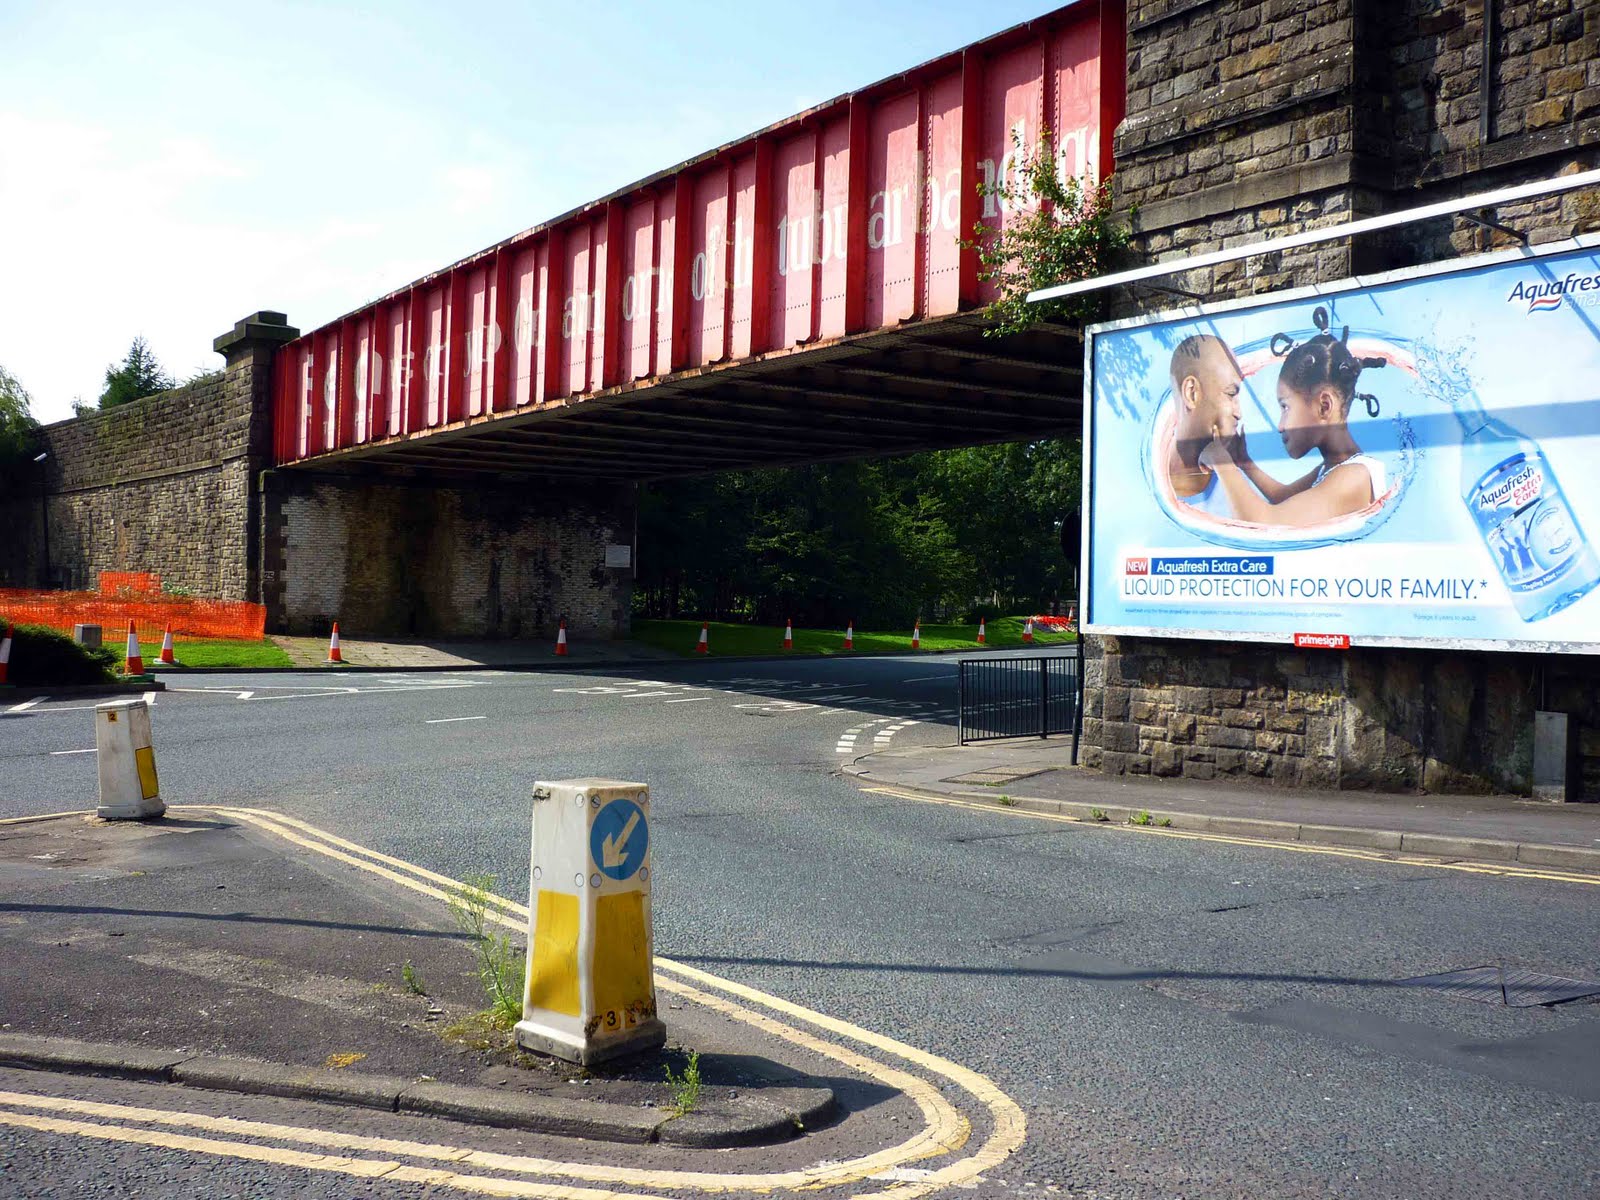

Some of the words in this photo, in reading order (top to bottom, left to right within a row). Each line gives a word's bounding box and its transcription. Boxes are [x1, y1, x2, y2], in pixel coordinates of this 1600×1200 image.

[1480, 466, 1535, 508] Aquafresh
[1126, 561, 1147, 572] NEW
[1156, 560, 1209, 576] Aquafresh
[1211, 560, 1238, 573] Extra
[1239, 559, 1267, 573] Care
[1124, 578, 1175, 596] LIQUID
[1179, 578, 1285, 598] PROTECTION
[1290, 578, 1329, 598] FOR
[1334, 578, 1393, 598] YOUR
[1298, 635, 1344, 648] primesight
[606, 1010, 617, 1027] 3
